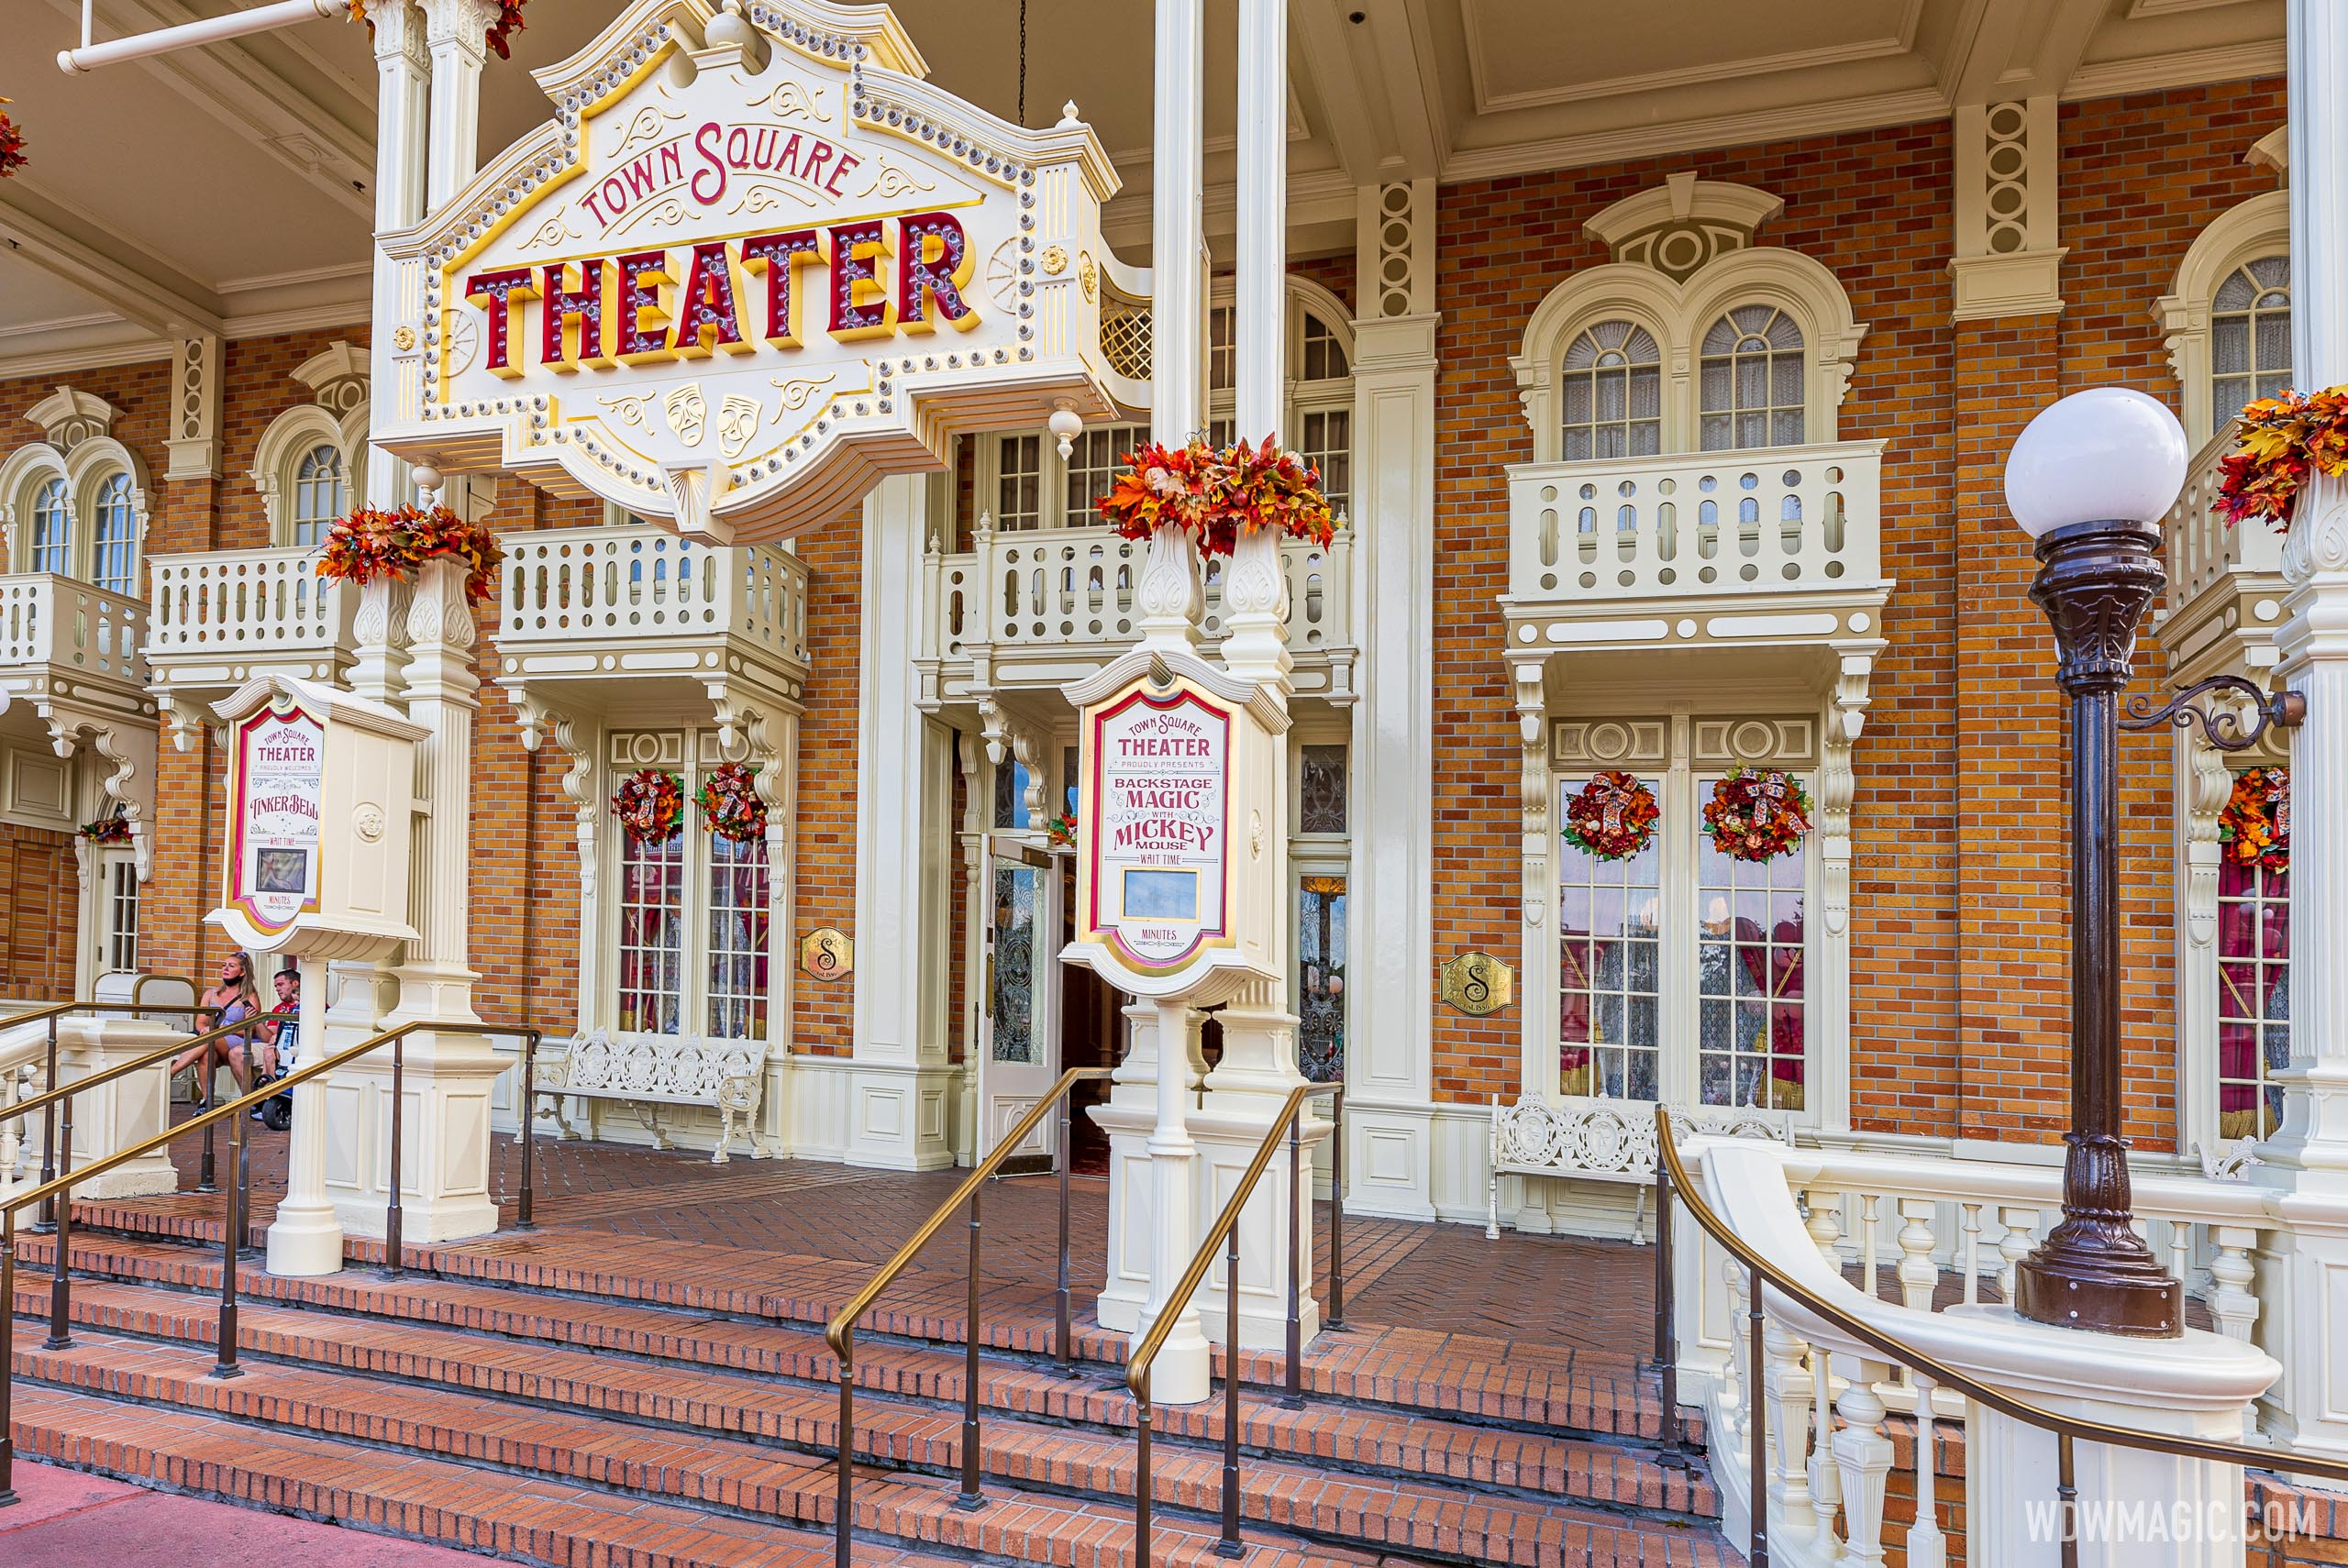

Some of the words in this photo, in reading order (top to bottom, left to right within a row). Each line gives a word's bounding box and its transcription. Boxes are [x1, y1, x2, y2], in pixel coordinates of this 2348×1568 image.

[581, 141, 684, 228] TOWN
[691, 121, 860, 205] SQUARE
[465, 212, 981, 380] THEATER
[1128, 717, 1156, 736] TOWN
[1157, 713, 1202, 737] SQUARE
[264, 730, 282, 745] TOWN
[282, 727, 310, 746] SQUARE
[258, 747, 315, 762] THEATER
[1118, 738, 1211, 756] THEATER
[1114, 778, 1213, 789] BACKSTAGE
[1125, 790, 1200, 809] MAGIC
[269, 836, 282, 846] WAIT
[1114, 820, 1213, 851] MICKEY
[1135, 841, 1188, 851] MOUSE
[1140, 854, 1160, 865] WAIT
[1163, 854, 1181, 866] TIME
[269, 895, 292, 905] MINUTES
[1141, 928, 1177, 941] MINUTES
[1465, 965, 1489, 1002] S
